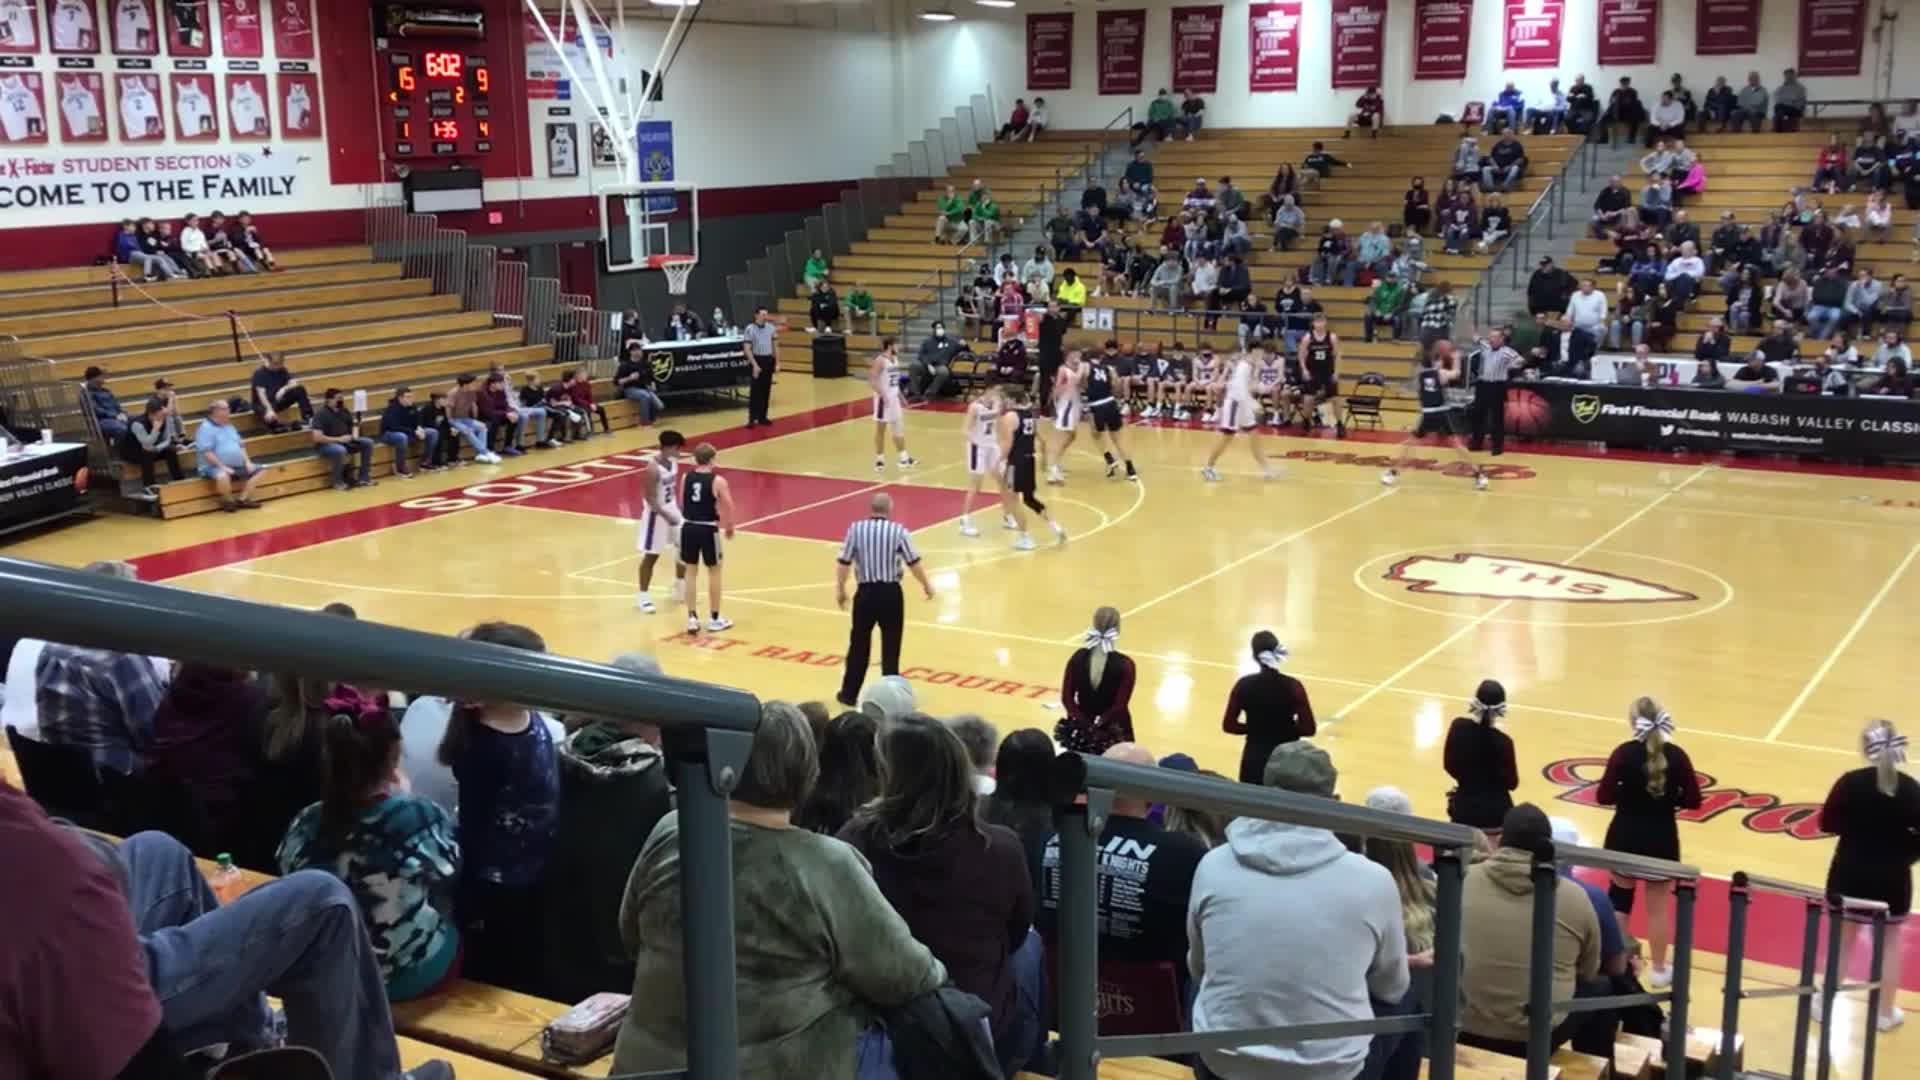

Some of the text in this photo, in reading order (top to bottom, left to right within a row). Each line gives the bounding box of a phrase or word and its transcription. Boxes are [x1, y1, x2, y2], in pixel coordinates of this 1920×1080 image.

[425, 53, 461, 77] 6:02
[476, 69, 489, 92] 9
[455, 86, 465, 103] 2
[403, 122, 409, 137] 1
[479, 121, 489, 137] 4
[62, 156, 150, 173] STUDENT
[154, 153, 231, 170] SECTION
[91, 182, 131, 203] TO
[138, 178, 195, 201] THE
[202, 173, 296, 200] FAMILY
[1601, 404, 1631, 416] First
[1632, 405, 1688, 419] Financial
[1689, 409, 1721, 421] Bank
[1727, 411, 1790, 426] WABASH
[1797, 415, 1855, 430] VALLEY
[691, 482, 702, 503] 3
[1487, 562, 1609, 595] THS
[901, 667, 1060, 699] COURT
